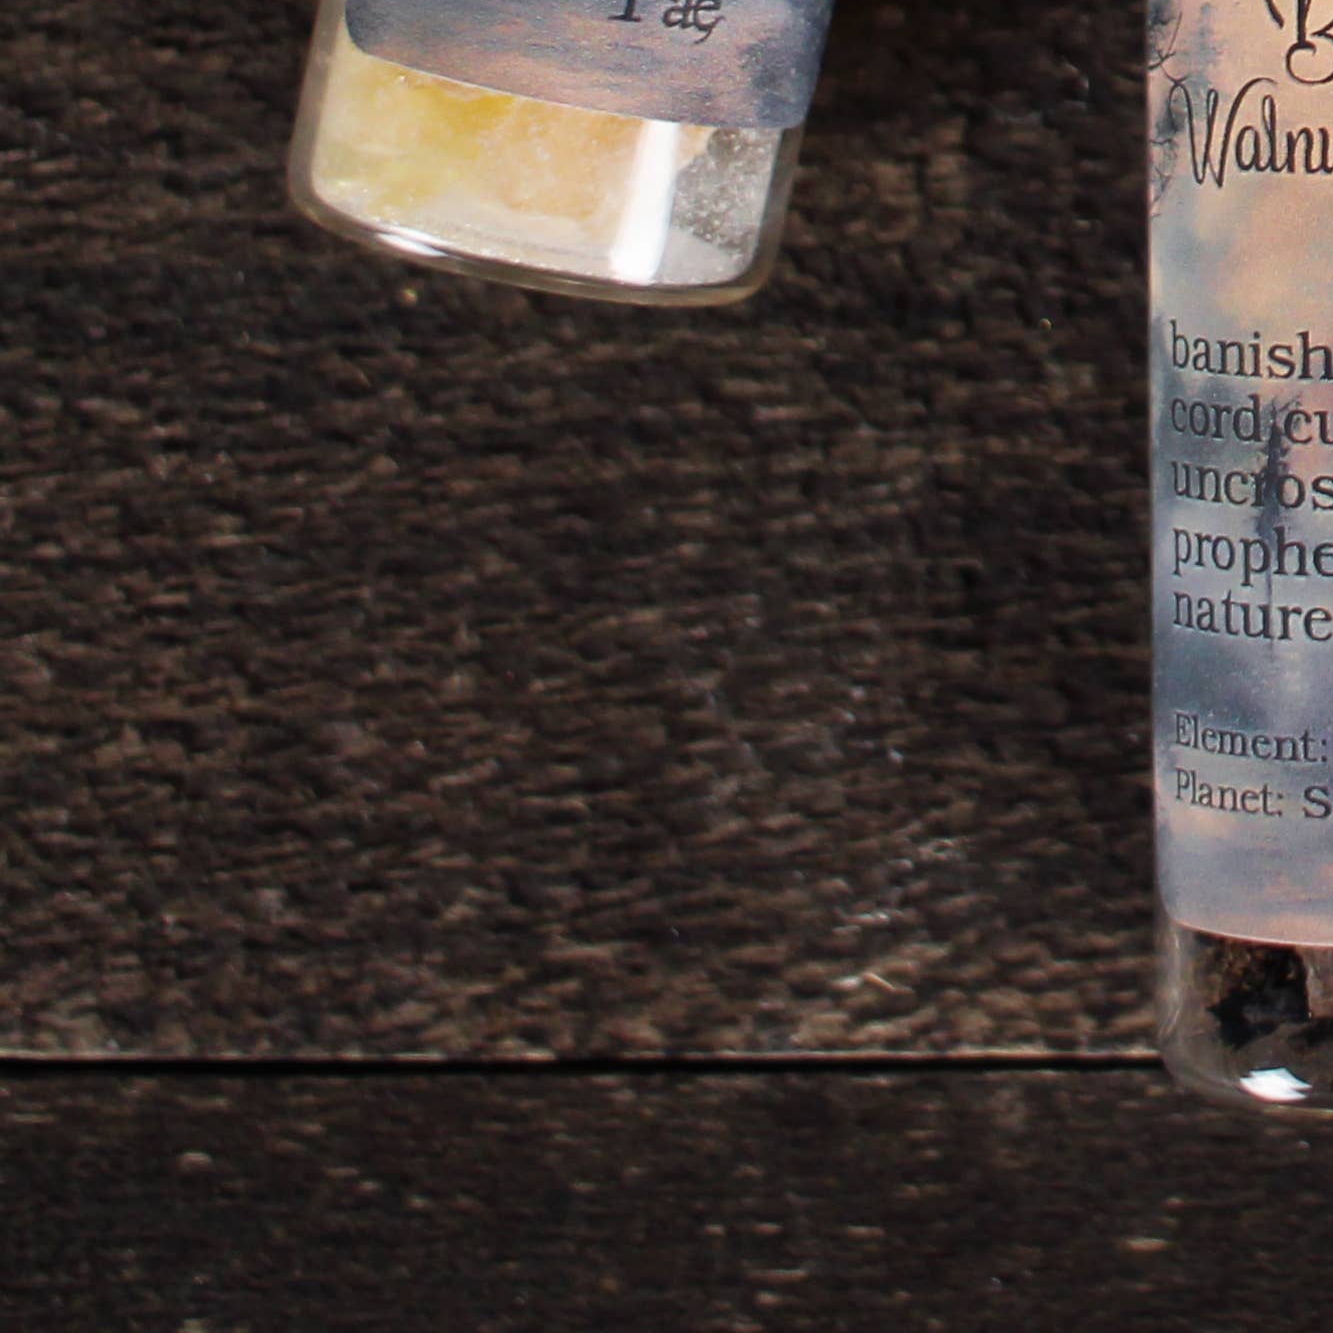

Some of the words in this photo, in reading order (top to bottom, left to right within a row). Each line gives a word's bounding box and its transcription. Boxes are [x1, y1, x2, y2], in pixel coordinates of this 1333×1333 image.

[1170, 394, 1263, 444] cord
[1174, 588, 1333, 642] nature
[1175, 713, 1329, 764] Element:
[1175, 768, 1283, 819] Planet:
